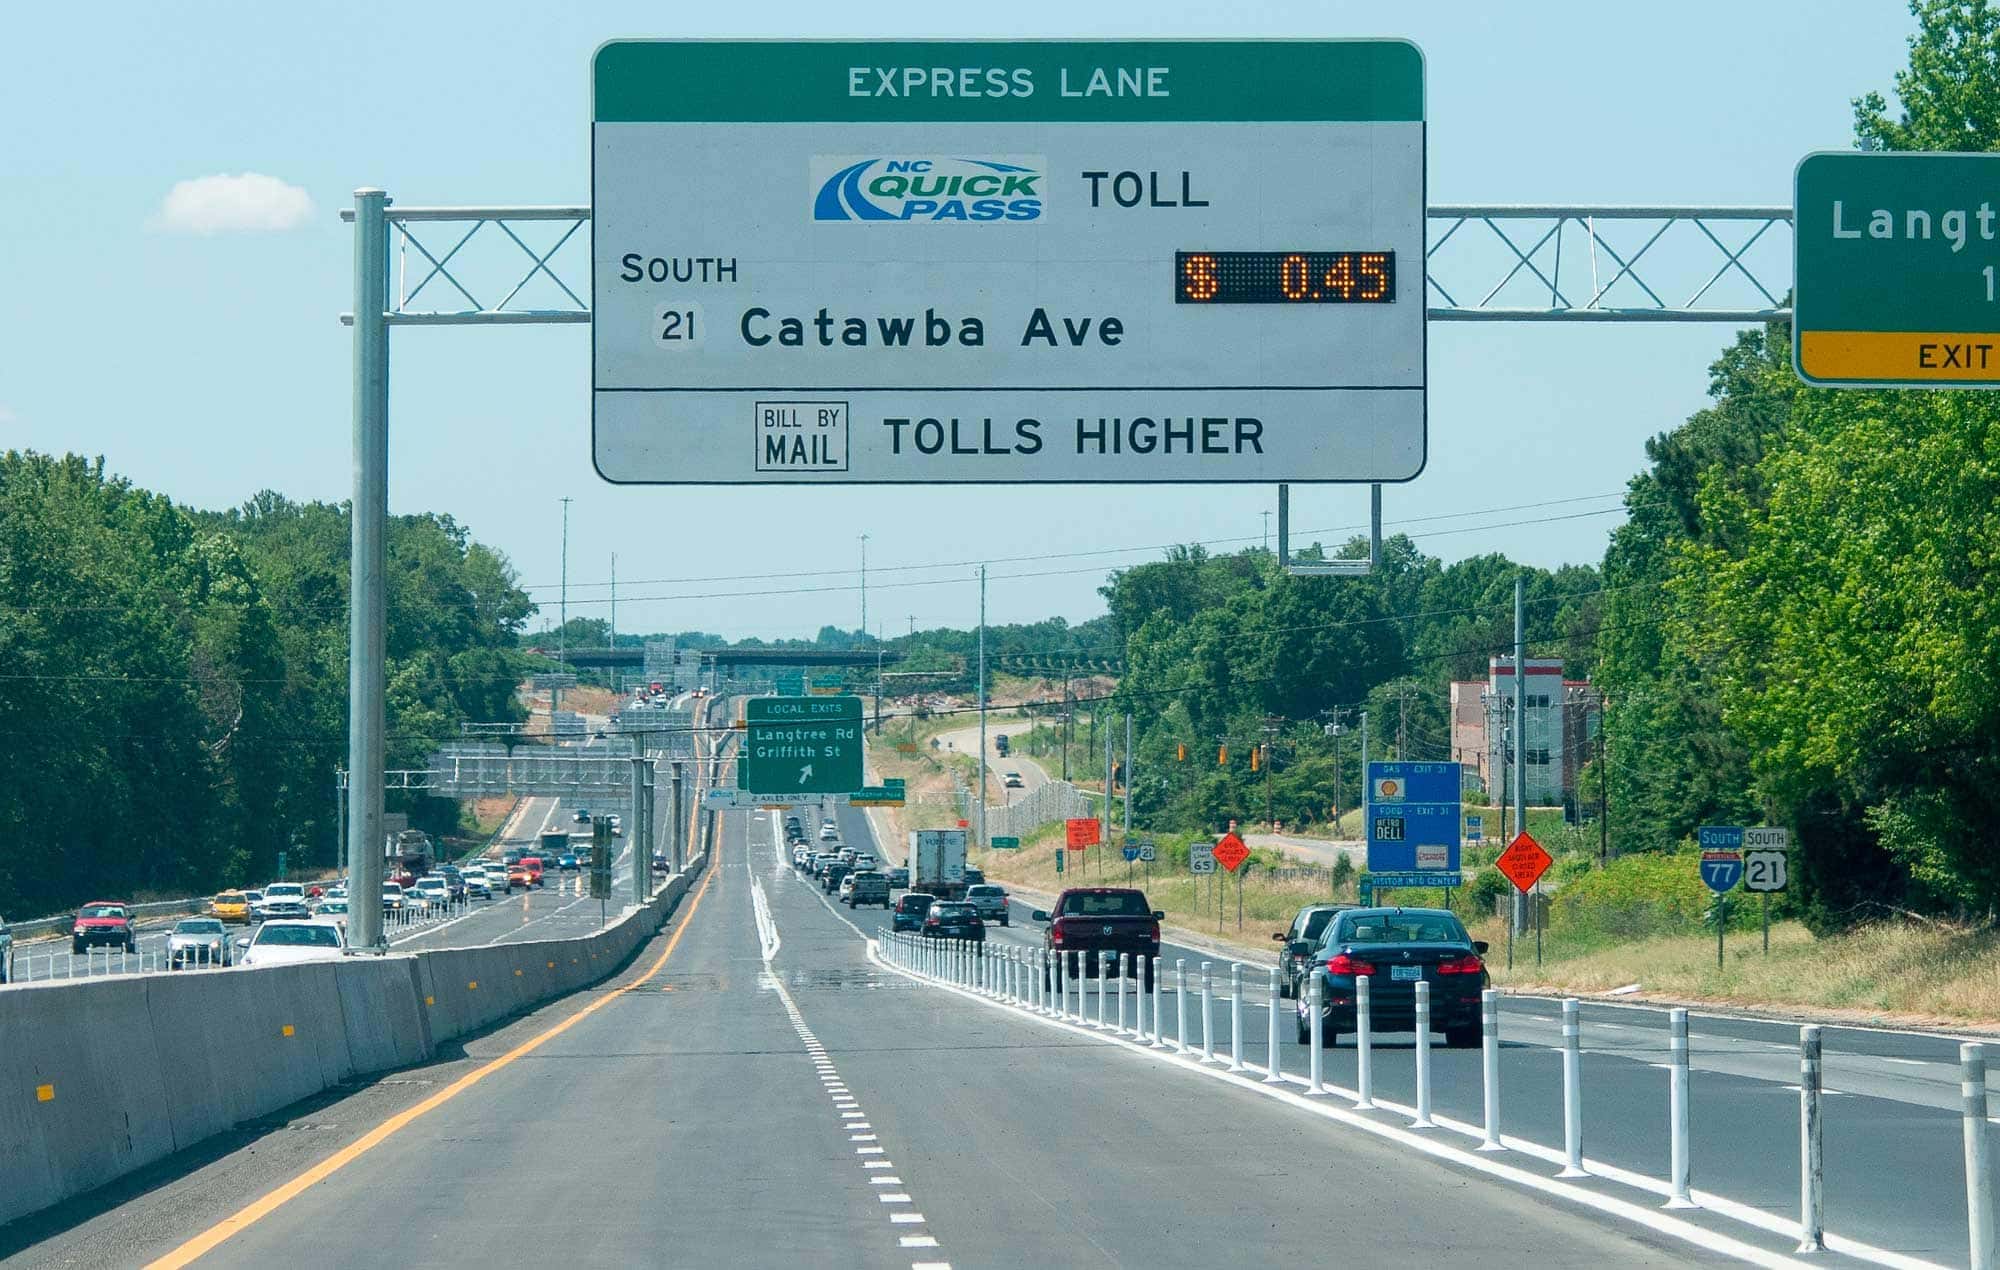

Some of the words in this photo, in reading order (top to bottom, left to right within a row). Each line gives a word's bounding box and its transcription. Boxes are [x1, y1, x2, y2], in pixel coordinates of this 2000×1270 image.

[848, 67, 1034, 98] EXPRESS
[1060, 67, 1170, 97] LANE
[886, 160, 933, 173] NC
[868, 175, 1043, 199] QUICK
[1081, 170, 1209, 207] TOLL
[900, 199, 1042, 221] PASS
[1832, 200, 1997, 253] Langt
[621, 253, 737, 283] SOUTH
[1184, 255, 1219, 299] $
[1280, 255, 1388, 299] 0.45
[1982, 265, 1995, 302] 1
[662, 310, 694, 340] 21
[741, 307, 984, 347] Catawba
[1020, 307, 1124, 347] Ave
[1919, 344, 1993, 369] EXIT
[764, 409, 802, 428] BILL
[818, 409, 840, 428] BY
[883, 418, 1043, 455] TOLLS
[1076, 417, 1264, 454] HIGHER
[766, 434, 838, 464] MAIL
[768, 704, 805, 714] LOCAL
[811, 704, 842, 713] EXITS
[756, 728, 827, 742] Langtree
[835, 728, 854, 739] Rd
[756, 746, 816, 758] Griffith
[824, 746, 841, 757] St
[1414, 765, 1433, 774] EXIT
[1380, 806, 1403, 815] FOOD
[1417, 807, 1435, 816] EXIT
[1702, 831, 1740, 845] SOUTH
[1747, 831, 1784, 845] SOUTH
[1193, 861, 1211, 871] 65
[1707, 863, 1734, 883] 77
[1751, 860, 1777, 883] 21
